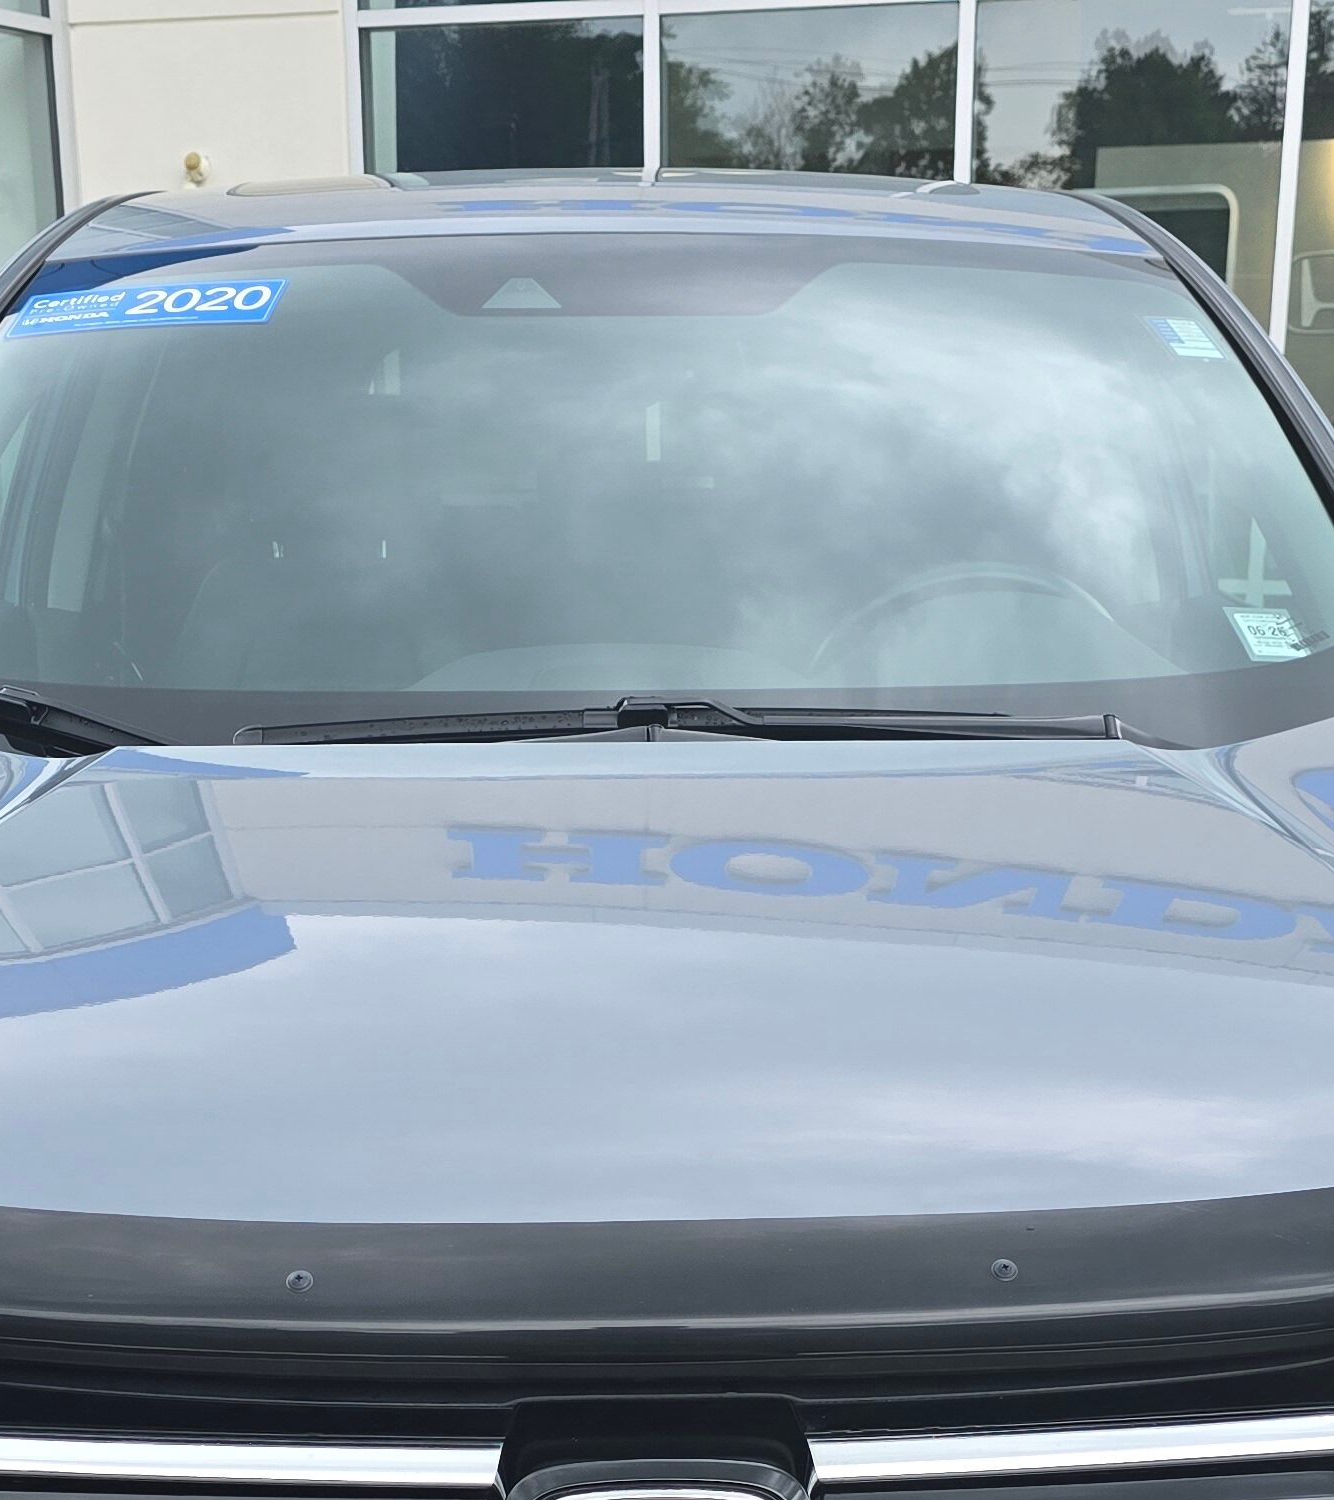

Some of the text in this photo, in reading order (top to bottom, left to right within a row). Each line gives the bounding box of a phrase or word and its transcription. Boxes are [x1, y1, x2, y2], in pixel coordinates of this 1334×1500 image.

[33, 291, 126, 309] Certified
[124, 285, 272, 315] 2020
[40, 311, 109, 324] HONDA
